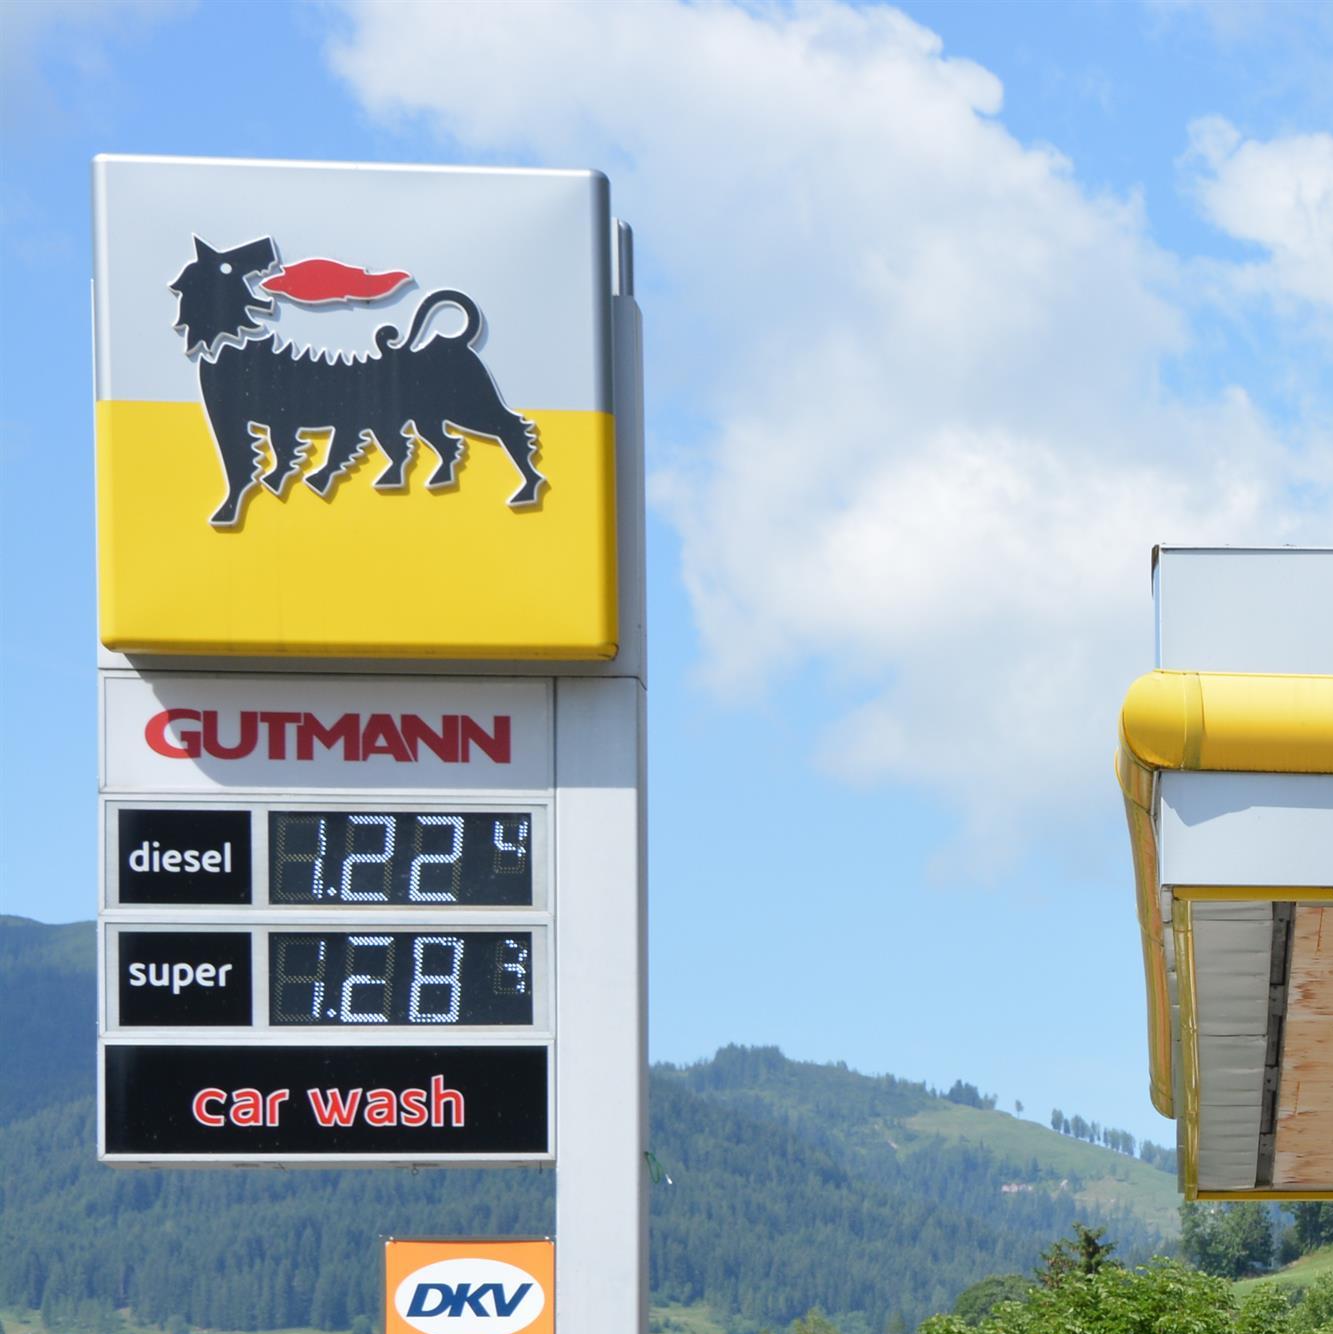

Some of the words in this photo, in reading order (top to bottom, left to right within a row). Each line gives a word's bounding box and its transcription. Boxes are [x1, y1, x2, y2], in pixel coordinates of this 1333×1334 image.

[144, 708, 511, 764] GUTMANN
[128, 842, 232, 874] diesel
[128, 961, 233, 994] super
[192, 1087, 289, 1128] car
[307, 1075, 465, 1129] wash
[405, 1282, 534, 1318] DKV
